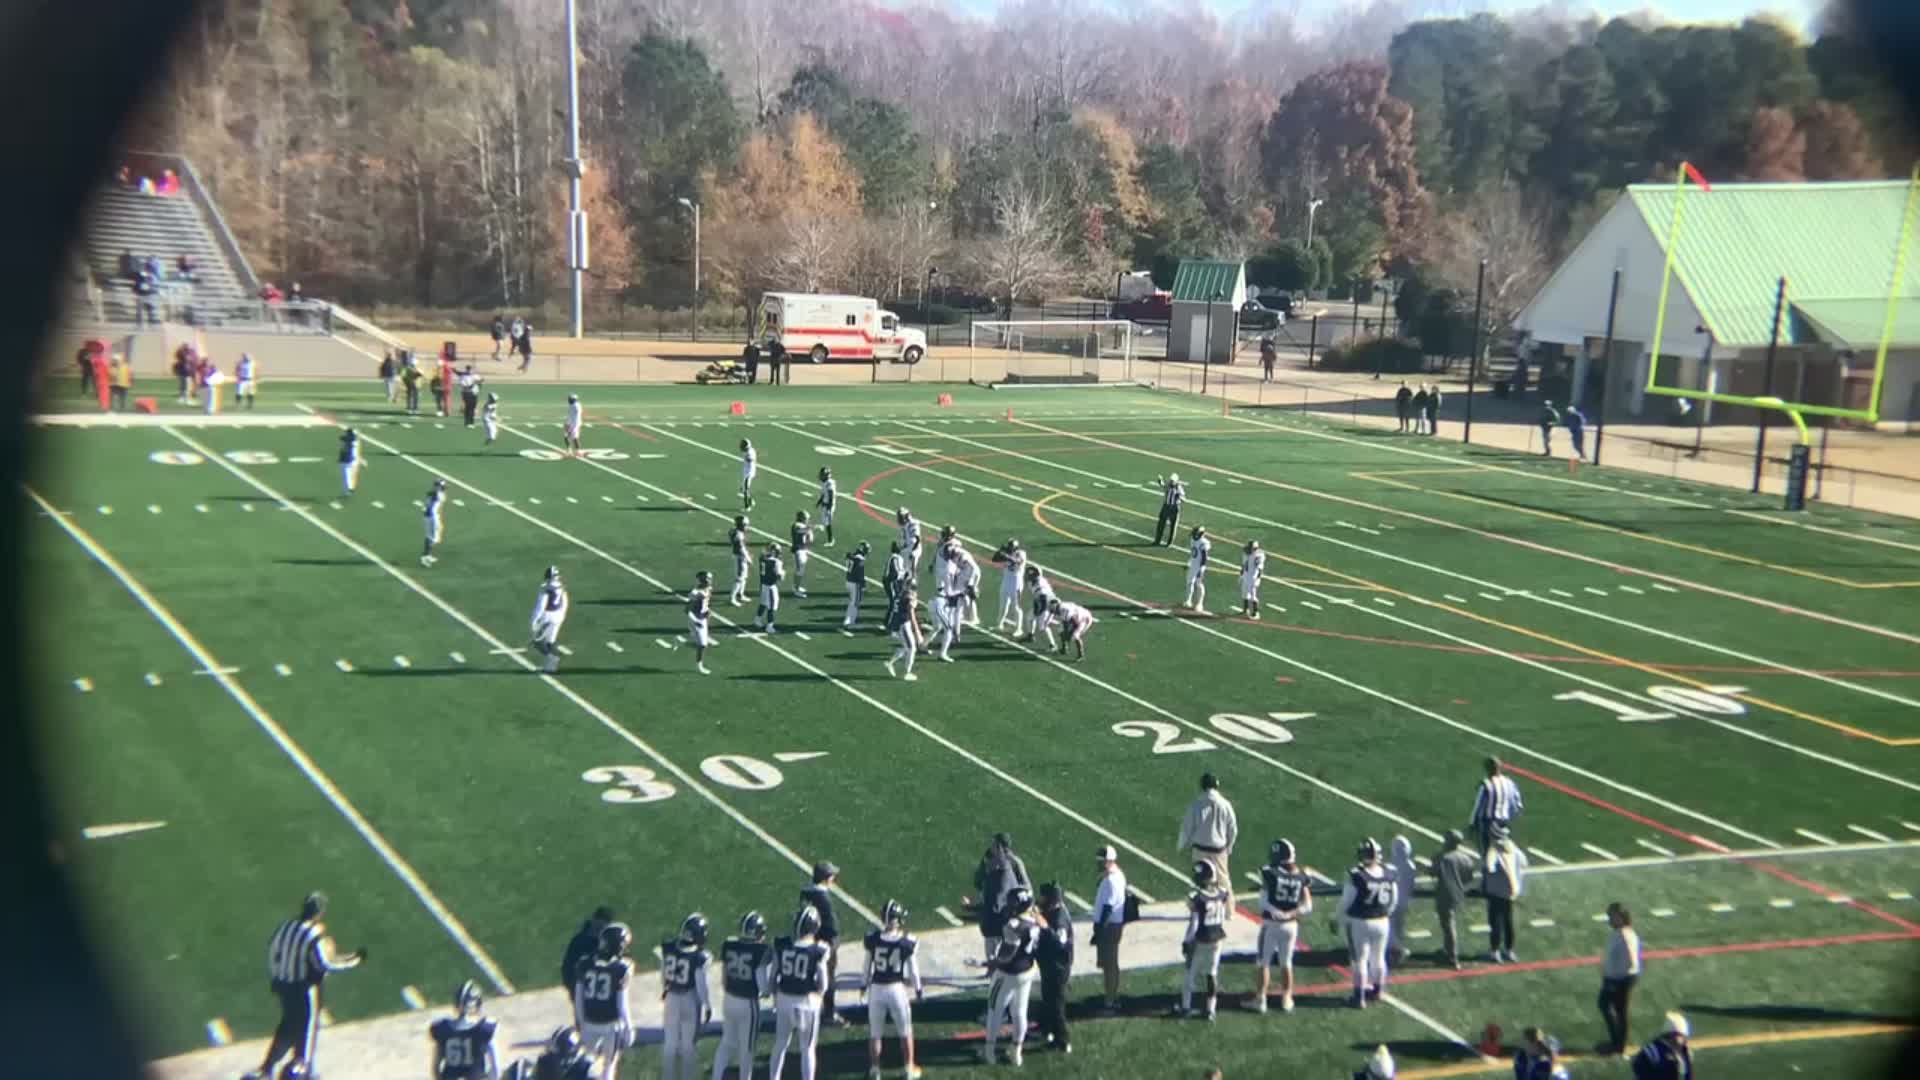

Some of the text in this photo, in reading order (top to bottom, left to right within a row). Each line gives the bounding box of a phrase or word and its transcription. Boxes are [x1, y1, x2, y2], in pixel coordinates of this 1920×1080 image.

[1552, 685, 1747, 721] 10
[1111, 713, 1294, 755] 20
[581, 754, 784, 803] 30
[1275, 876, 1301, 902] 53
[1366, 881, 1389, 904] 76
[664, 954, 690, 985] 23
[726, 950, 753, 980] 26
[782, 950, 808, 979] 50
[874, 947, 900, 972] 54
[584, 970, 612, 1001] 33
[445, 1036, 474, 1067] 61
